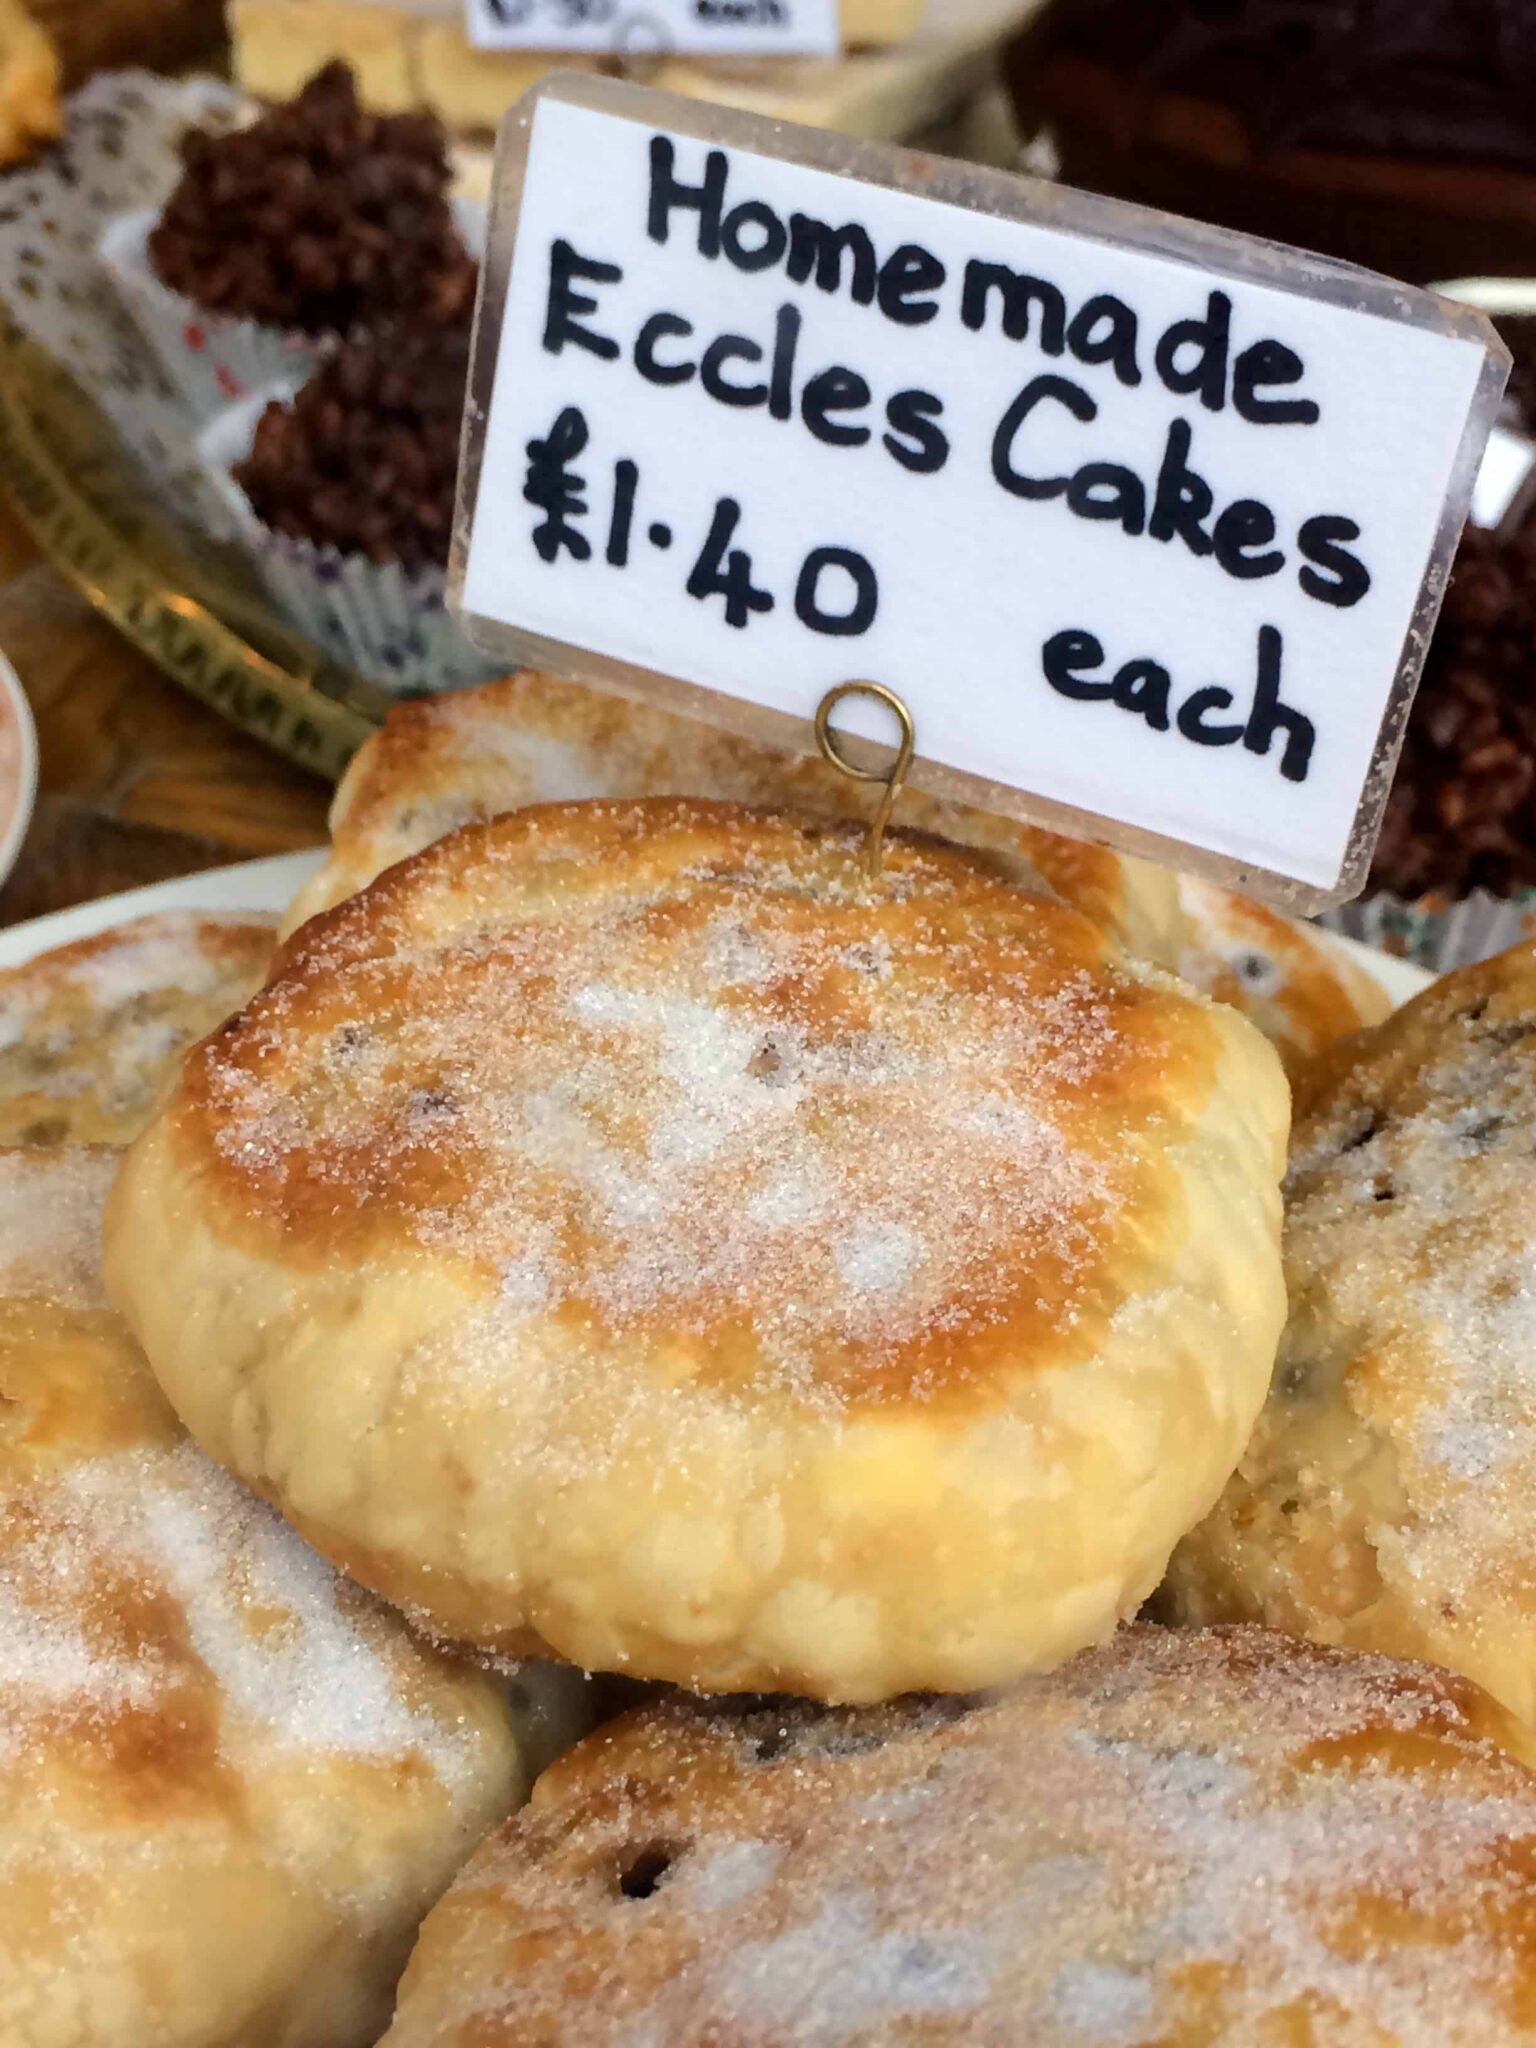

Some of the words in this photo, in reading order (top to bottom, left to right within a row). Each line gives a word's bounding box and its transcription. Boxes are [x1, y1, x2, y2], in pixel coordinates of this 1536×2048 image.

[542, 239, 950, 474] Eccles
[991, 374, 1371, 608] Cakes
[647, 136, 1320, 425] Homemade
[1042, 624, 1316, 783] each
